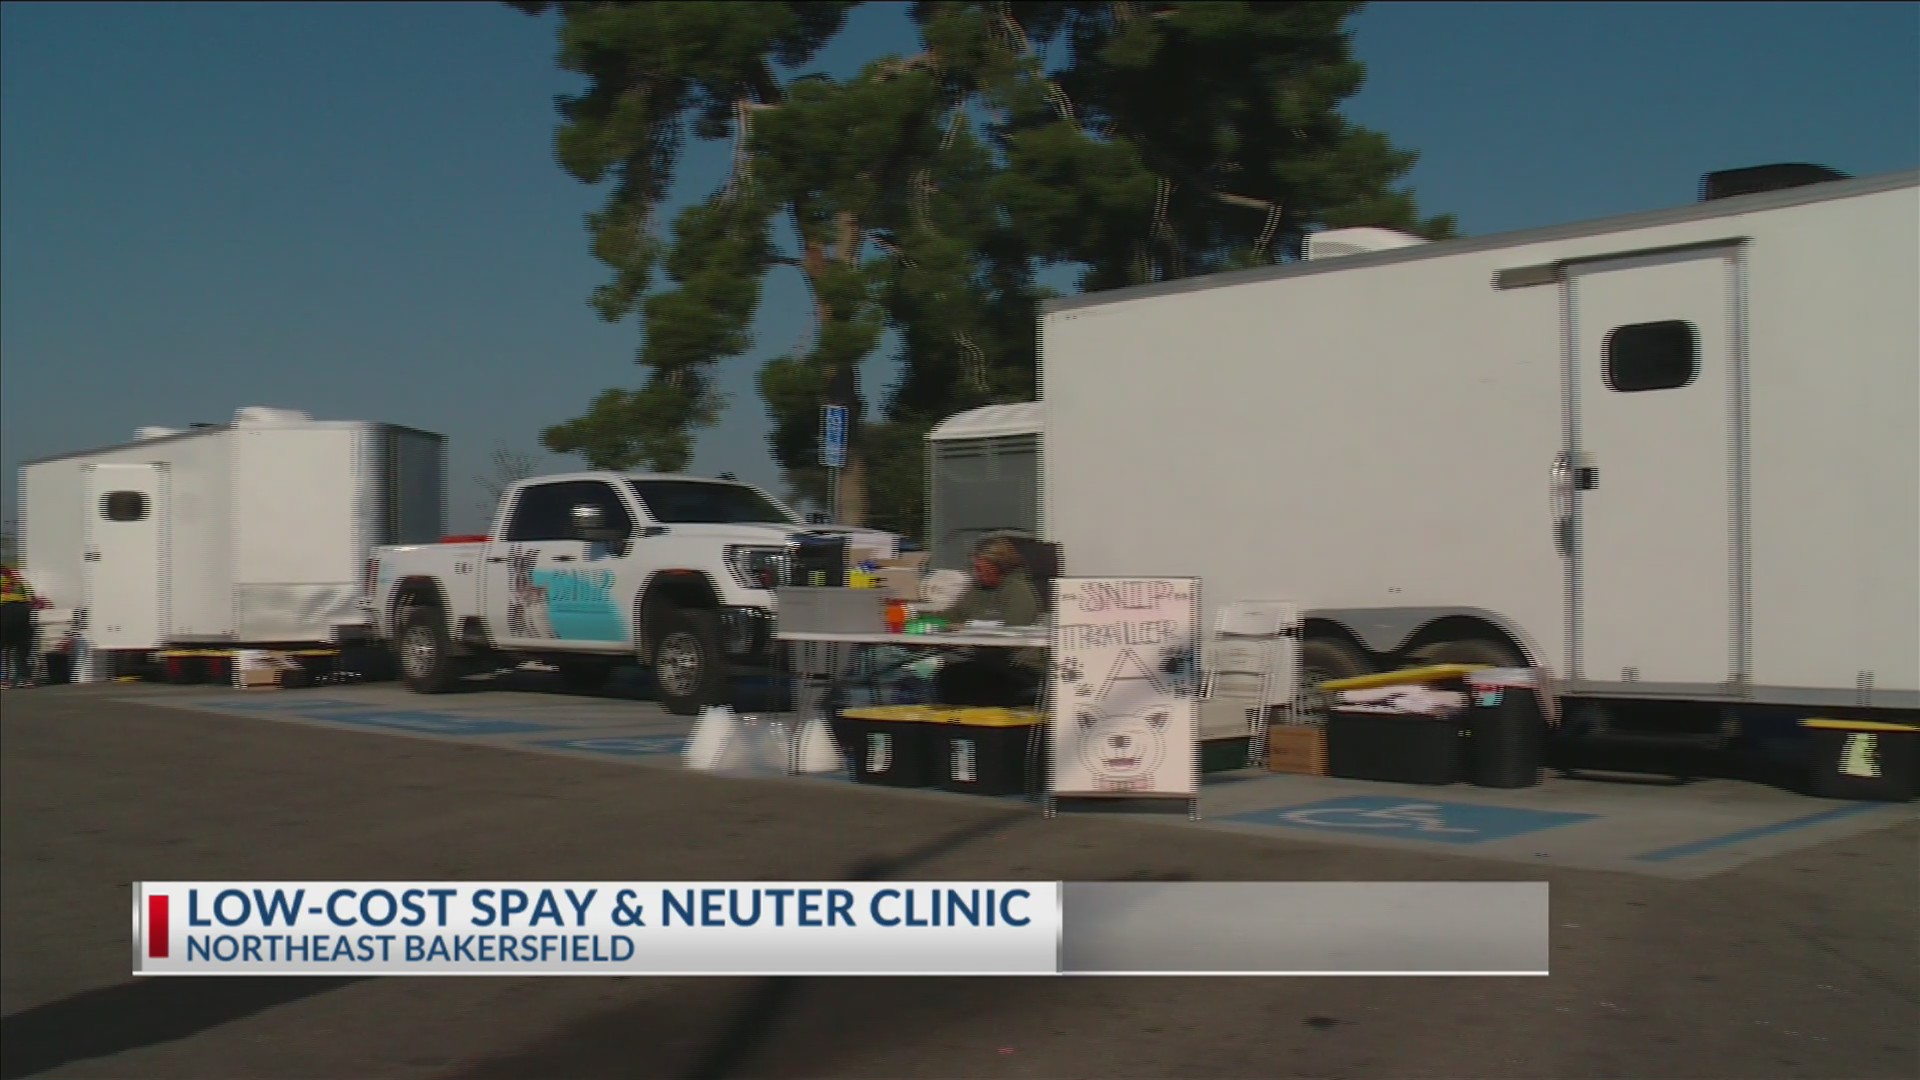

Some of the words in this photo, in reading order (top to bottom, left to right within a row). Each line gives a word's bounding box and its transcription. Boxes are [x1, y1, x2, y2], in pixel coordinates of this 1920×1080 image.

[551, 568, 615, 603] SNIP
[1079, 580, 1174, 612] SNIP
[1055, 618, 1180, 650] TRAILER
[1095, 648, 1170, 701] A
